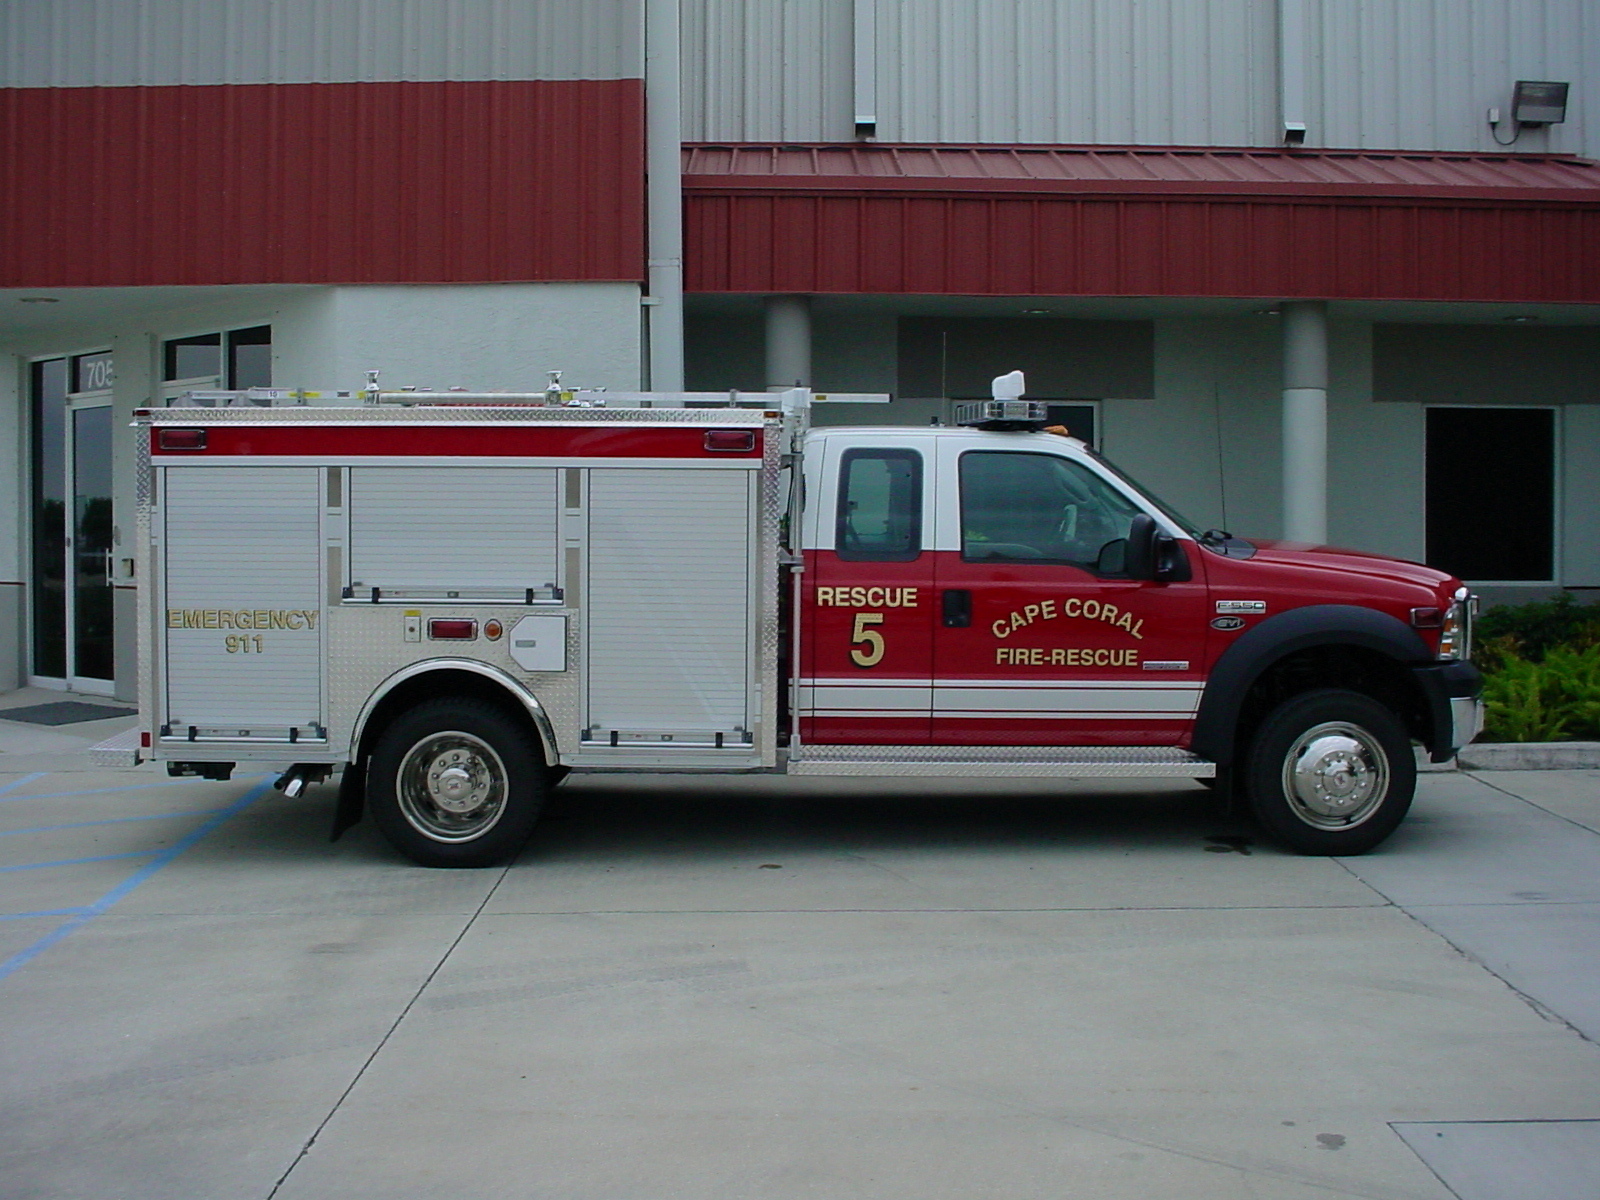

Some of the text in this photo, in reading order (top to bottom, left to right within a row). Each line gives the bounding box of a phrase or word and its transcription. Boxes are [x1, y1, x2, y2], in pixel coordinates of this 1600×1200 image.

[817, 586, 918, 608] RESCUE
[167, 609, 319, 630] EMERGENCY
[992, 598, 1144, 640] CAPE CORAL
[225, 633, 264, 654] 911
[850, 612, 885, 668] 5
[996, 648, 1139, 666] FIRE-RESCUE
